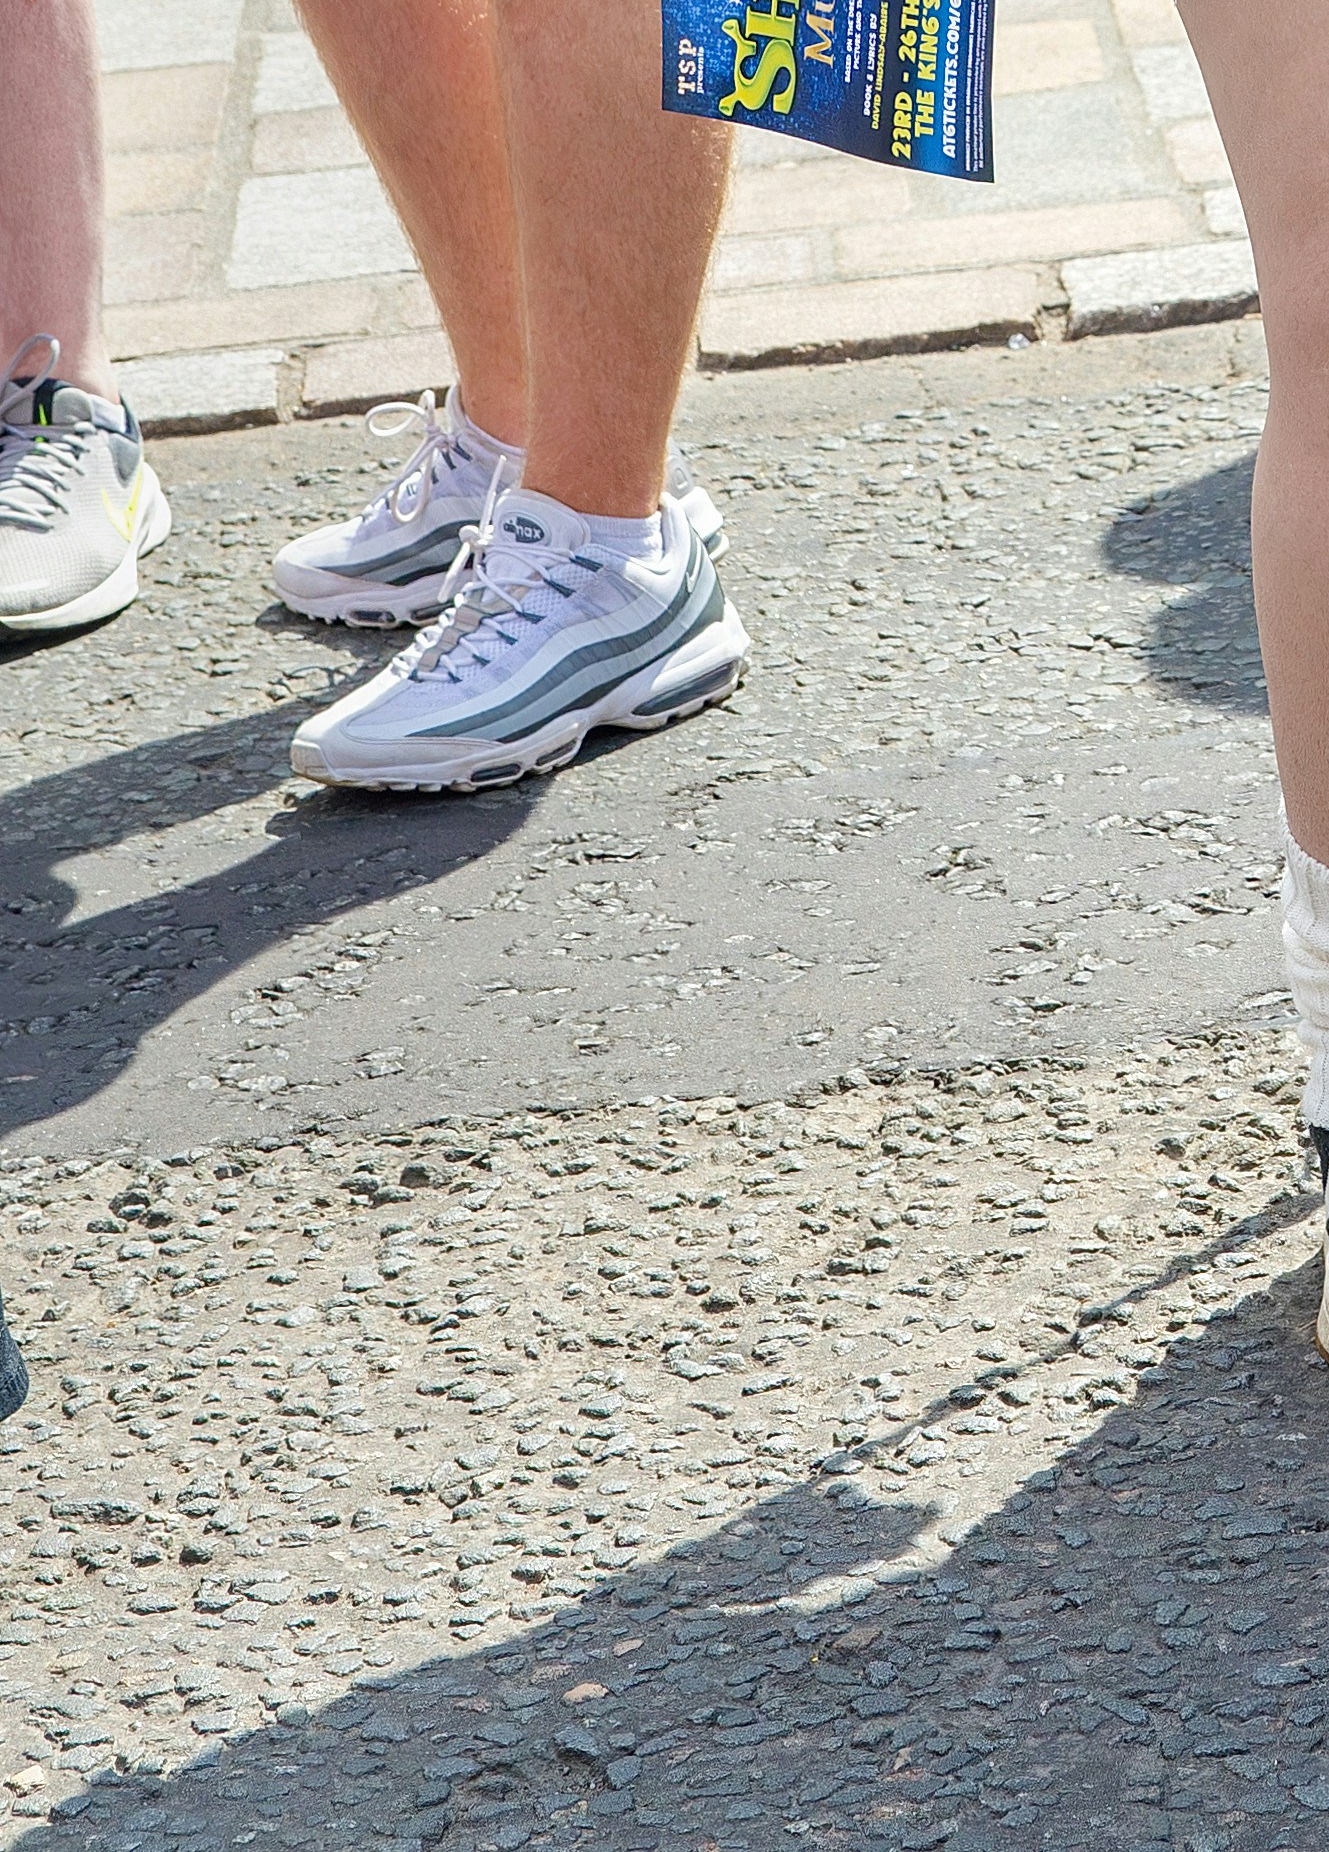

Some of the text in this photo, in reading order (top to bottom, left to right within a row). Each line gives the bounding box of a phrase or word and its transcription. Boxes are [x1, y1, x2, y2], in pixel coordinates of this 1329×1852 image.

[870, 13, 877, 30] BY
[846, 39, 853, 52] ON
[867, 32, 876, 70] LYRICS
[678, 39, 696, 95] TSP
[864, 84, 872, 116] BOOK
[871, 94, 880, 129] DAVID
[914, 89, 934, 138] THE
[891, 91, 912, 160] 23RD
